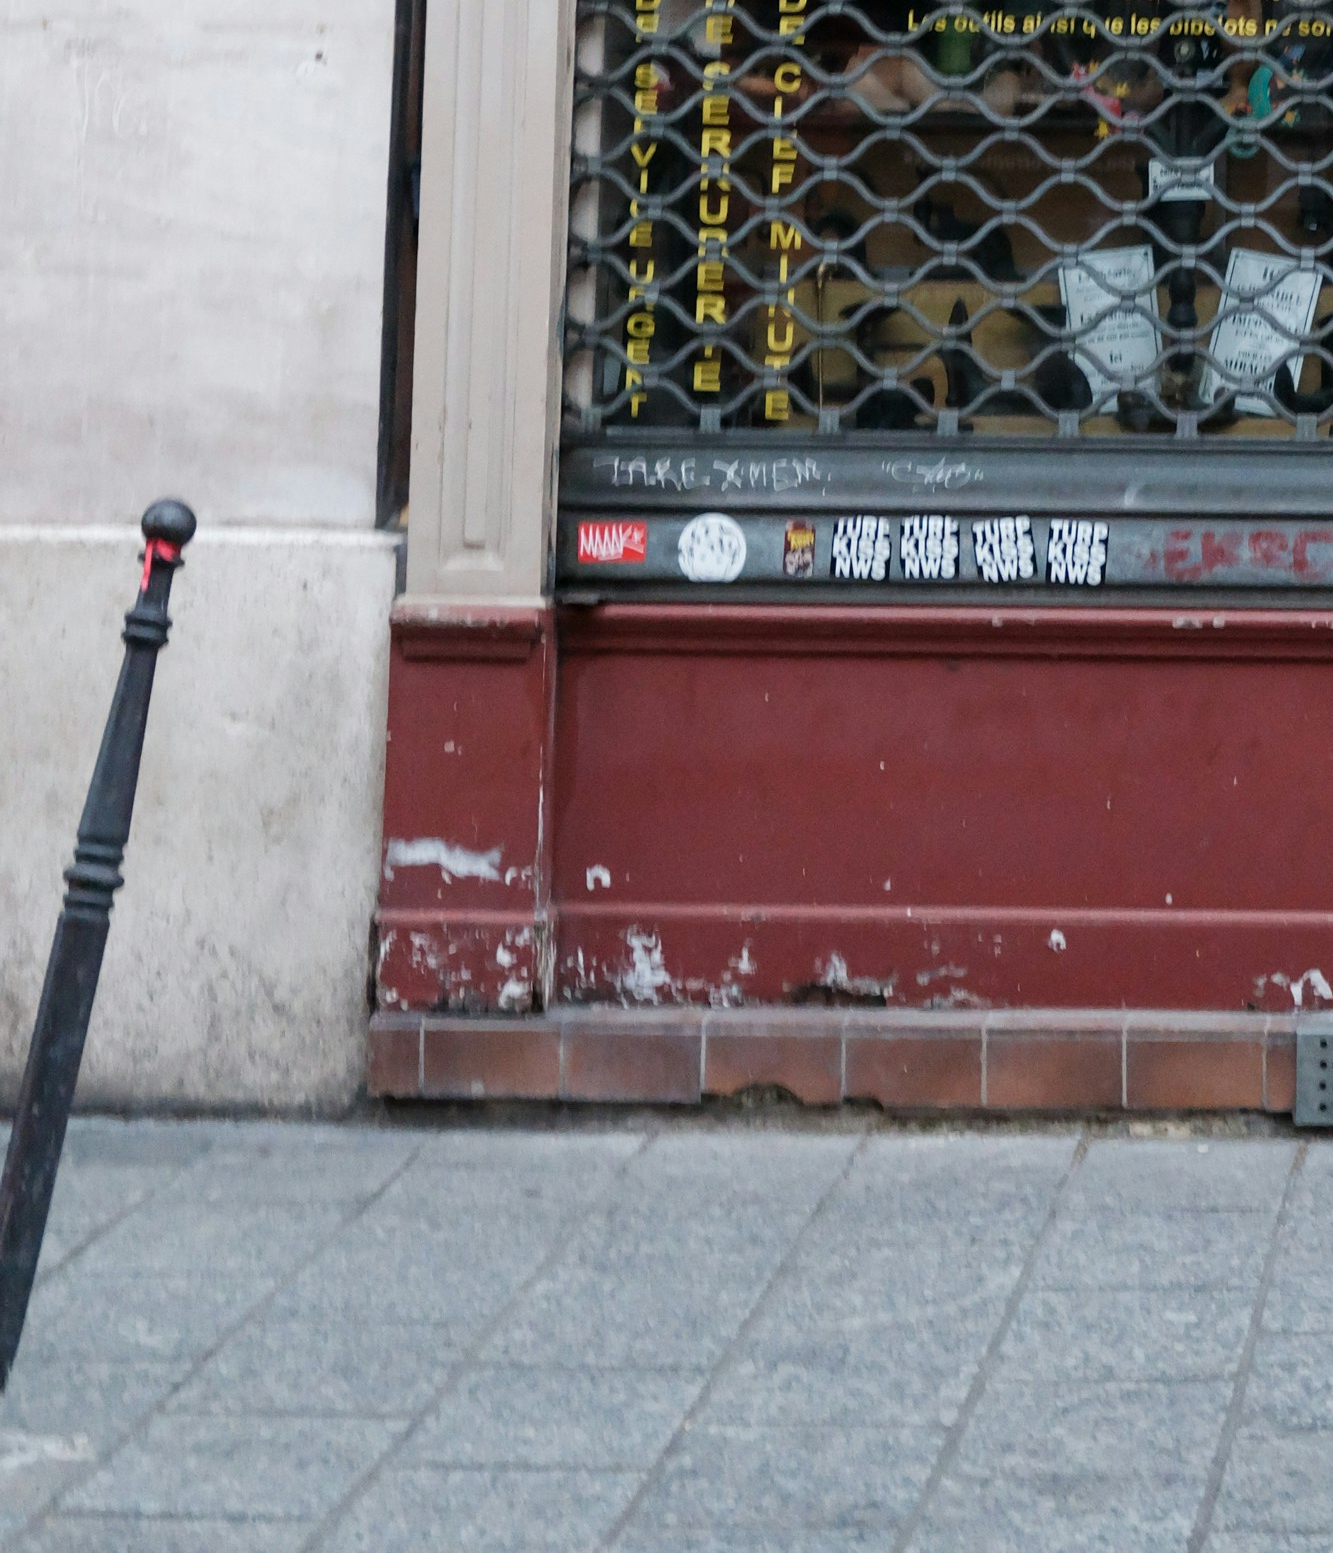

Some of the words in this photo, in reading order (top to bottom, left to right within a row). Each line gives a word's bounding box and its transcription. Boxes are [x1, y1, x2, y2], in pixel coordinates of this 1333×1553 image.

[834, 555, 886, 581] NWS
[903, 555, 956, 580] NWS
[981, 555, 1034, 584] NWS
[1050, 559, 1102, 587] NWS
